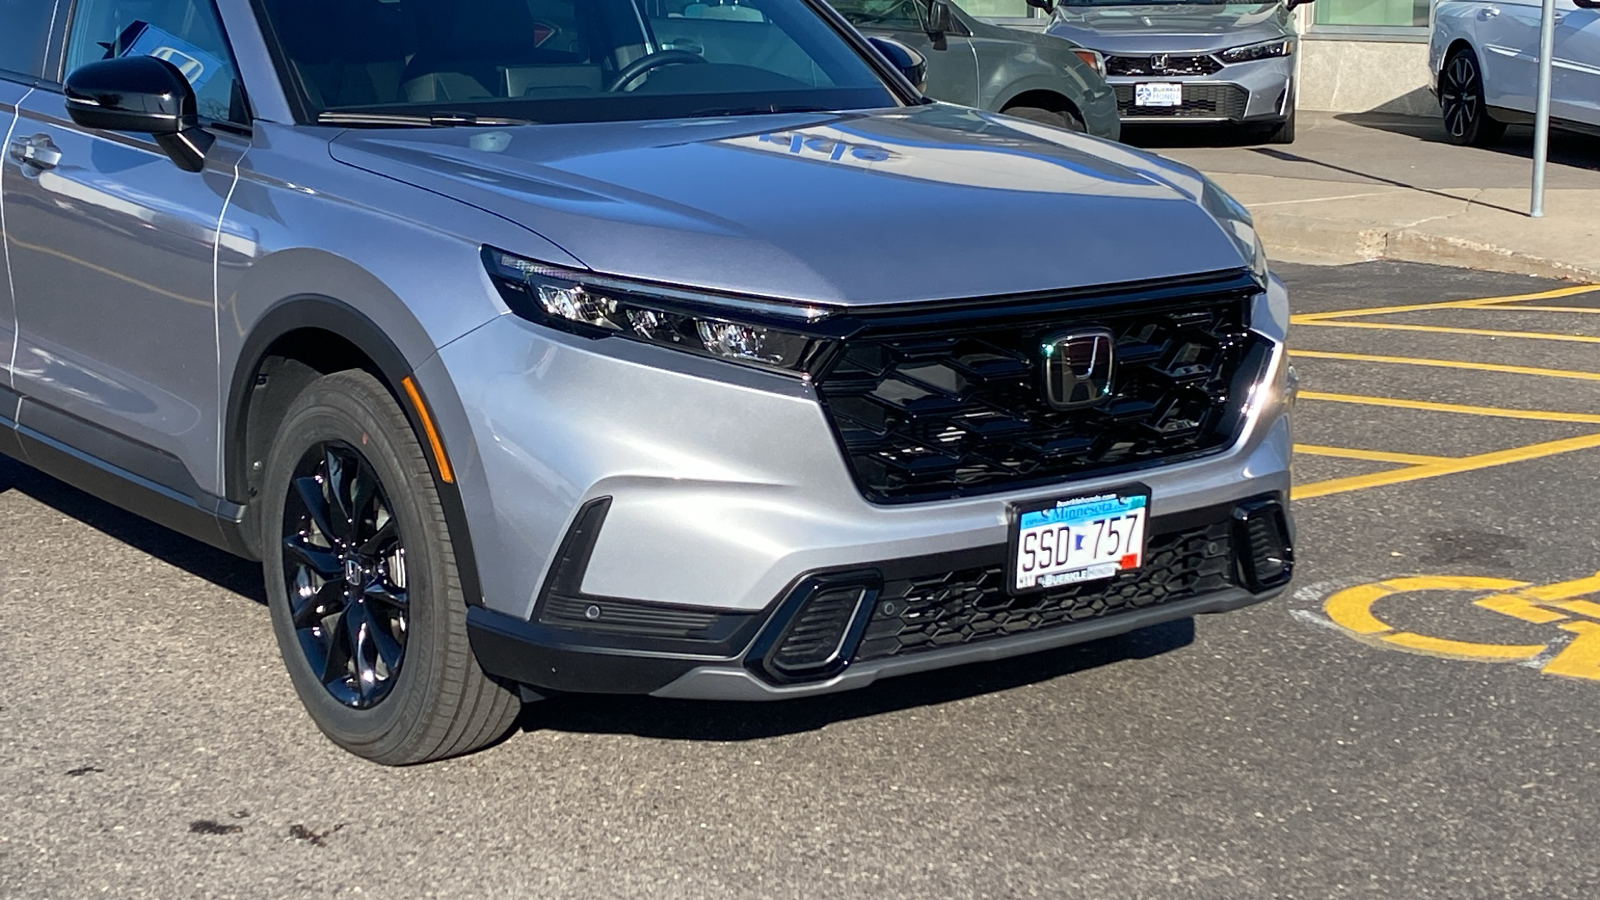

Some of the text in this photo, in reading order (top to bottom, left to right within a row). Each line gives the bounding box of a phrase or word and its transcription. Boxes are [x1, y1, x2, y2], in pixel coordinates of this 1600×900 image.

[1052, 502, 1113, 521] Minnesota
[1022, 514, 1138, 572] SSD 757
[1045, 570, 1087, 585] BUERKLE
